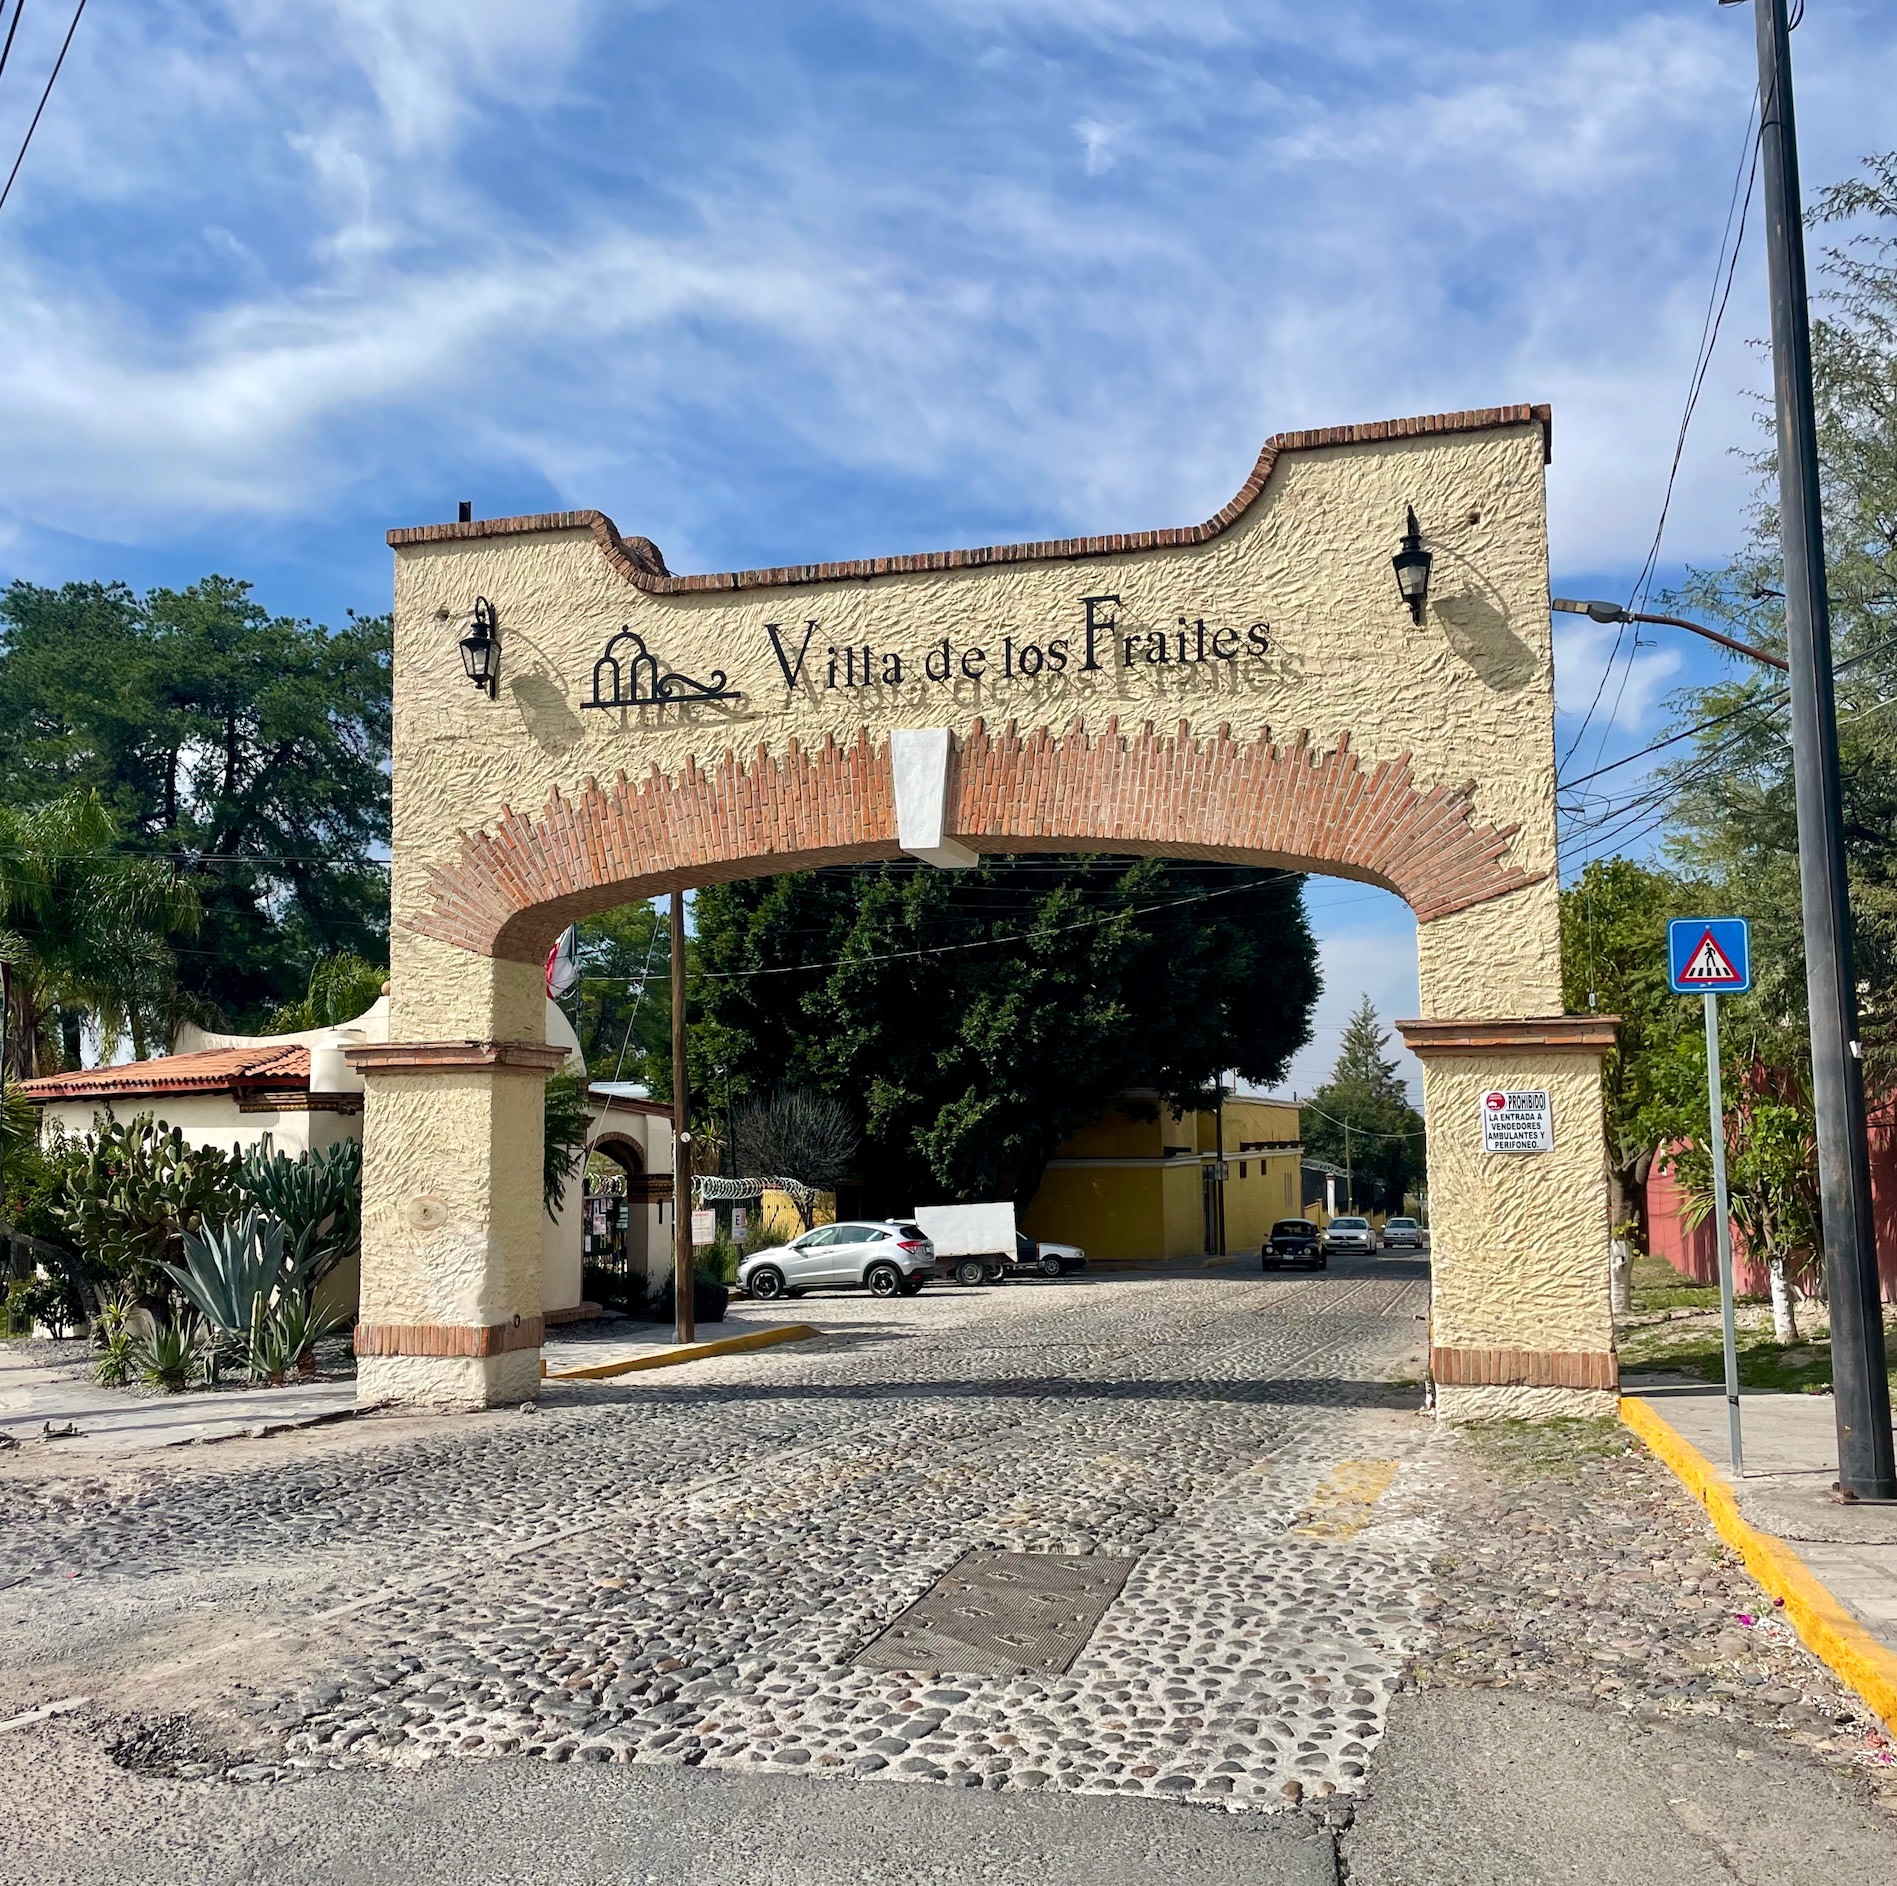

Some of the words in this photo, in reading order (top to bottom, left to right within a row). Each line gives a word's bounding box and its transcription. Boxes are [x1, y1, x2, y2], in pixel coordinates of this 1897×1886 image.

[764, 619, 903, 691] Villa
[925, 637, 987, 683] de
[1002, 636, 1069, 679] los
[1077, 594, 1271, 671] Frailes
[1508, 1094, 1544, 1109] PROHIBIDO
[1489, 1113, 1499, 1121] LA
[1500, 1113, 1535, 1121] ENTRADA
[1537, 1113, 1543, 1121] A
[1491, 1122, 1541, 1130] VENDEDORES
[1488, 1131, 1538, 1140] AMBULANTES
[1540, 1131, 1545, 1139] Y
[1495, 1141, 1540, 1149] PERIFONEO.
